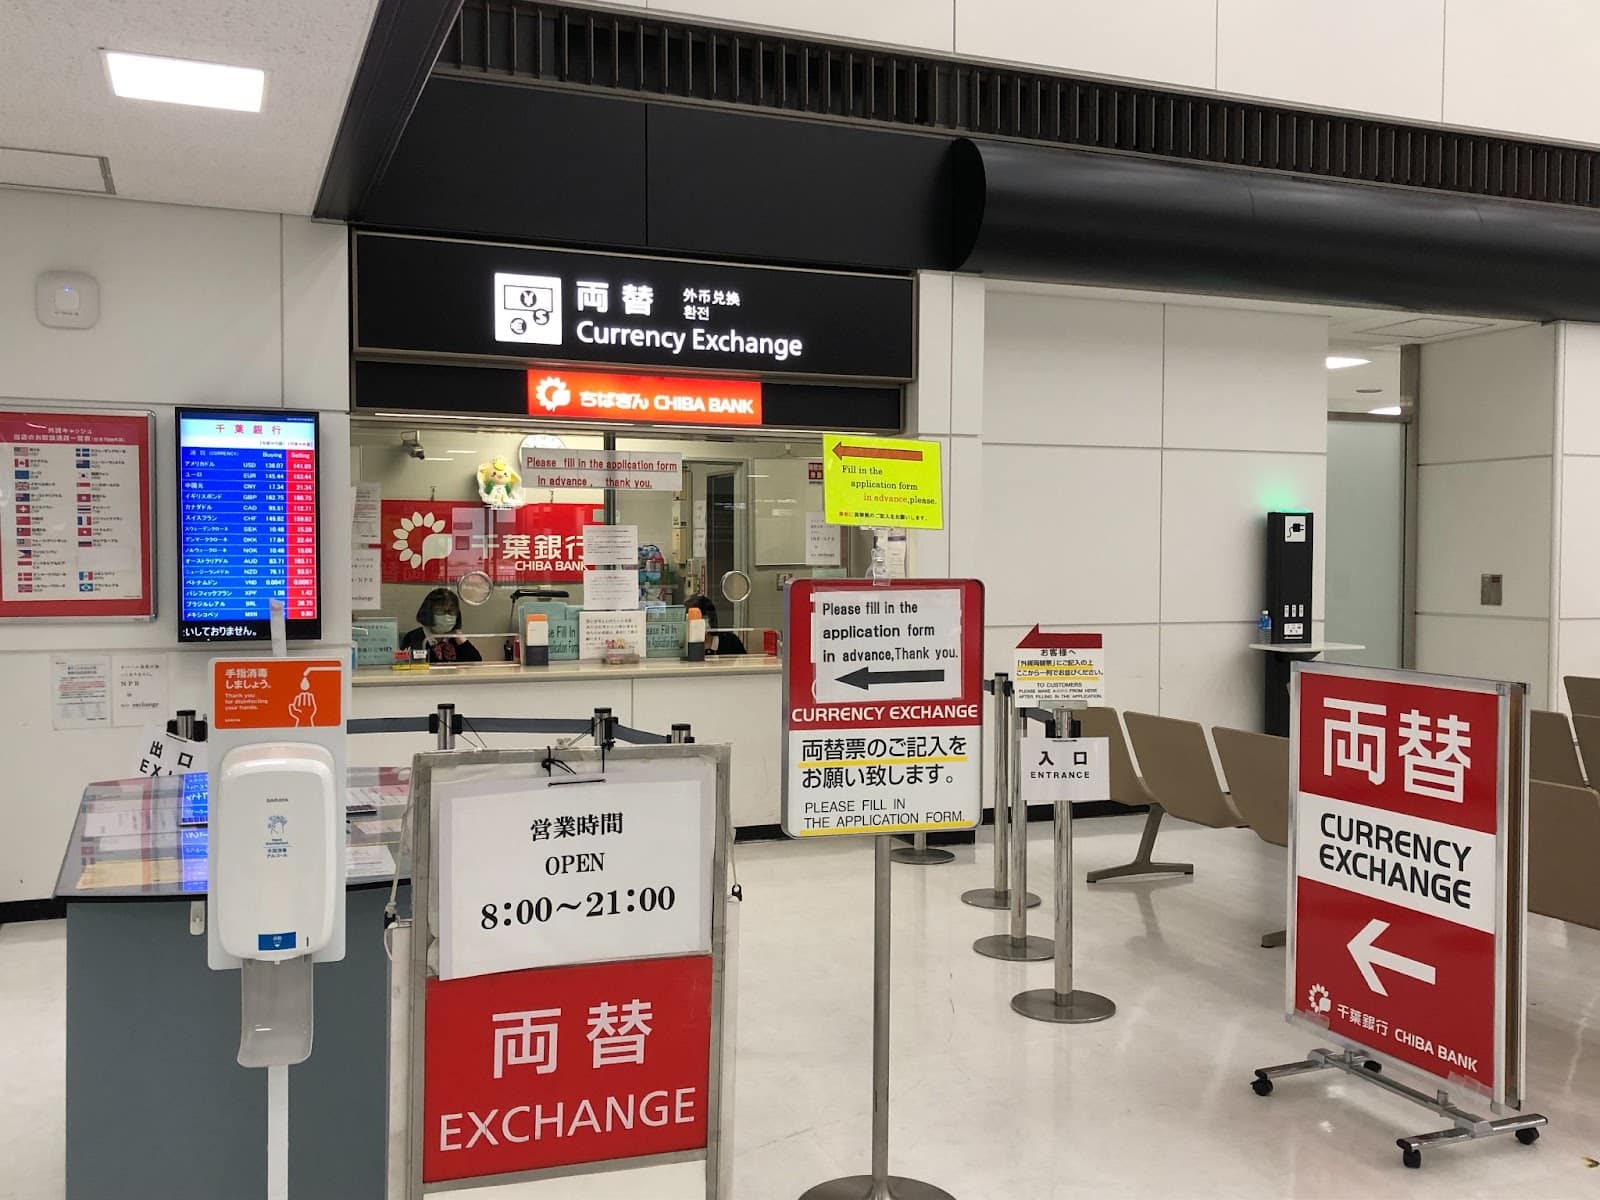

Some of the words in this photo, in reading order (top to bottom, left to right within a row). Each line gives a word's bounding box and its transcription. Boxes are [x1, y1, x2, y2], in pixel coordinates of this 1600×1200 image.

[575, 280, 654, 316] 両替
[683, 288, 741, 307] 外币兑换
[684, 304, 710, 321] 환전
[575, 320, 687, 354] Currency
[692, 328, 803, 361] Exchange
[654, 394, 705, 411] CHIBA
[709, 397, 754, 414] BANK
[216, 424, 281, 435] 千葉銀行
[262, 451, 282, 459] Buying
[527, 456, 557, 467] Please
[564, 457, 575, 467] fill
[578, 458, 586, 468] in
[590, 458, 603, 468] the
[606, 459, 654, 471] application
[657, 460, 677, 471] form
[842, 464, 856, 474] Fill
[859, 466, 867, 474] in
[869, 466, 883, 475] the
[605, 476, 631, 487] thank
[850, 479, 897, 490] application
[899, 481, 918, 490] form
[864, 493, 872, 501] in
[515, 560, 553, 571] CHIBA
[555, 560, 588, 572] BANK
[822, 602, 861, 616] Please
[866, 601, 880, 615] fill
[884, 602, 895, 614] in
[900, 601, 918, 614] the
[183, 626, 257, 637] いしておりません。
[823, 624, 901, 641] application
[907, 624, 935, 636] form
[823, 650, 835, 663] in
[935, 647, 959, 660] you.
[1040, 649, 1077, 657] お客様へ
[225, 668, 268, 679] 手指消毒
[225, 679, 272, 689] しましょう。
[791, 706, 885, 722] CURRENCY
[889, 704, 978, 720] EXCHANGE
[149, 740, 194, 769] 出口
[801, 735, 967, 761] 両替票のご記入を
[1323, 697, 1472, 804] 両替
[1038, 751, 1088, 766] 入口
[139, 758, 173, 777] EX
[1030, 771, 1090, 779] ENTRANCE
[801, 764, 953, 789] お願い致します。
[804, 800, 856, 814] PLEASE
[862, 799, 887, 811] FILL
[893, 798, 906, 810] IN
[529, 811, 624, 842] 営業時間
[804, 817, 830, 829] THE
[836, 813, 919, 827] APPLICATION
[925, 810, 966, 823] FORM.
[1320, 812, 1472, 872] CURRENCY
[545, 852, 606, 876] OPEN
[1319, 843, 1471, 910] EXCHANGE
[492, 998, 653, 1079] 両替
[1337, 1003, 1390, 1037] 千葉銀行
[1394, 1028, 1435, 1056] CHIBA
[1437, 1044, 1478, 1073] BANK
[440, 1087, 697, 1152] EXCHANGE
